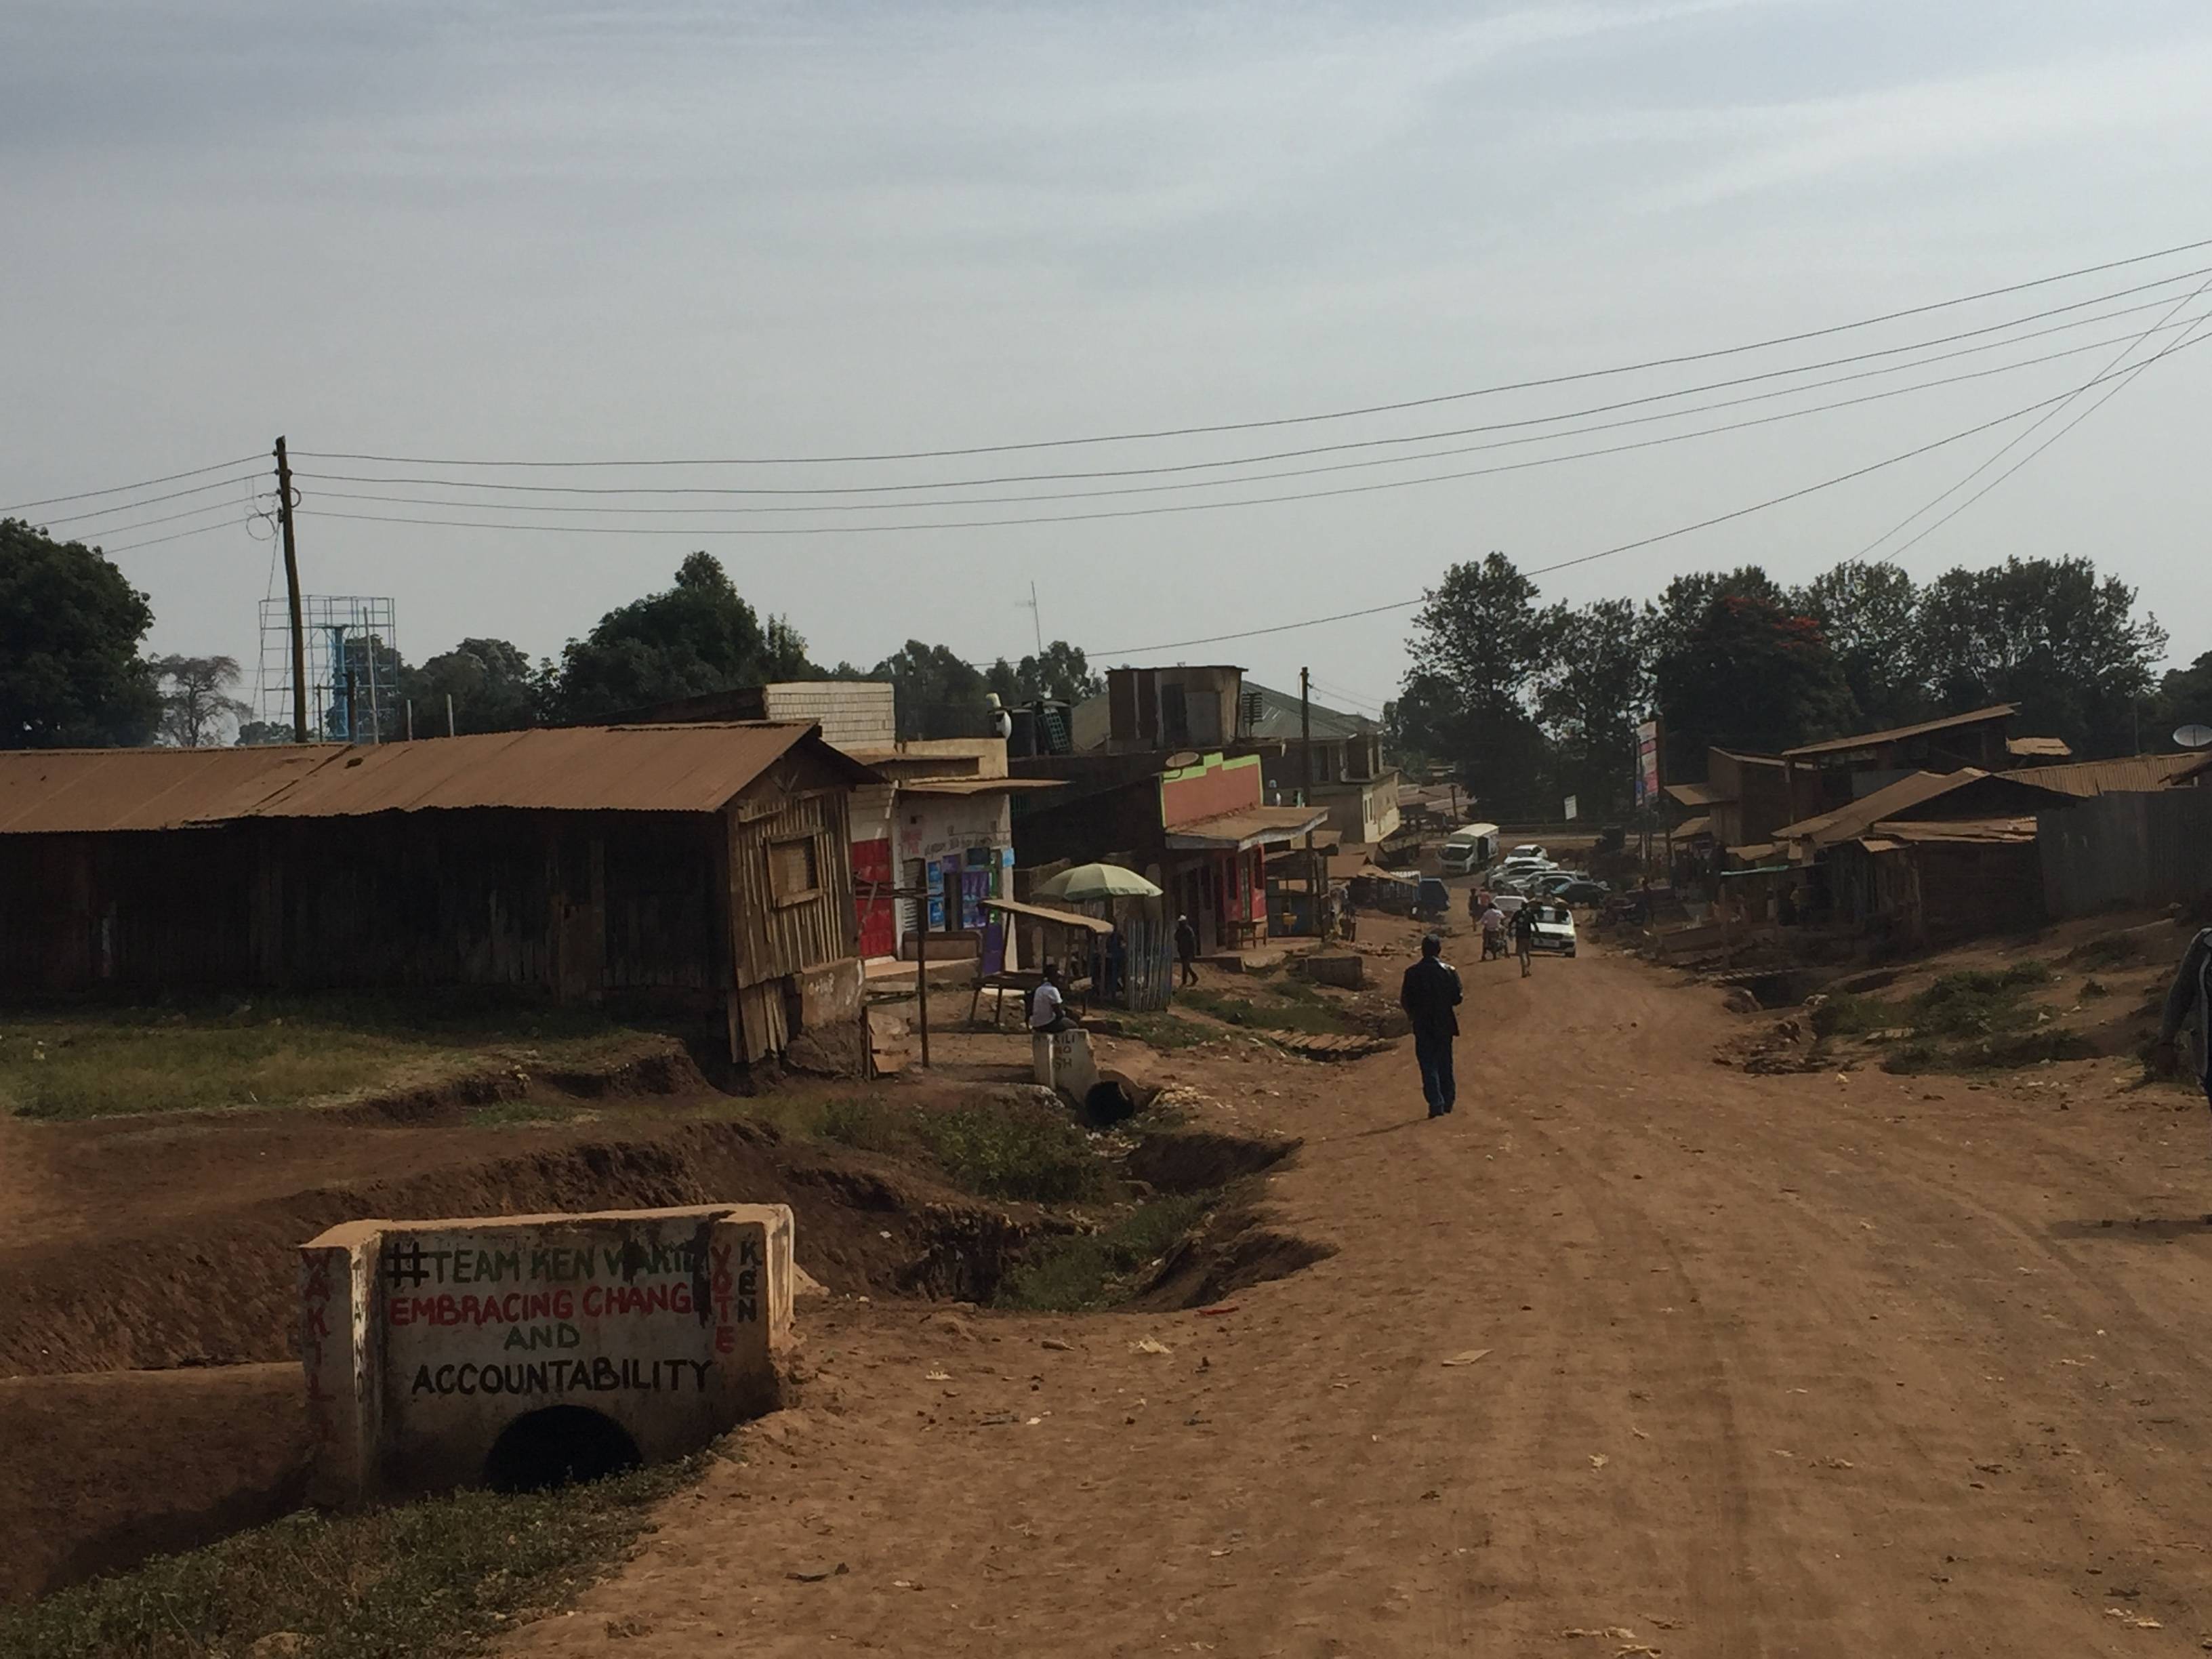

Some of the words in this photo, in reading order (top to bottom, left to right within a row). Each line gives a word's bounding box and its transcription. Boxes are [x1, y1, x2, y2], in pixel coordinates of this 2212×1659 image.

[388, 1242, 520, 1287] #TEAM
[531, 1247, 595, 1281] KEN
[390, 1289, 574, 1326] EMBRACING
[582, 1282, 697, 1317] CHANG
[504, 1322, 580, 1351] AND
[412, 1357, 714, 1395] ACCOUNTABILITY
